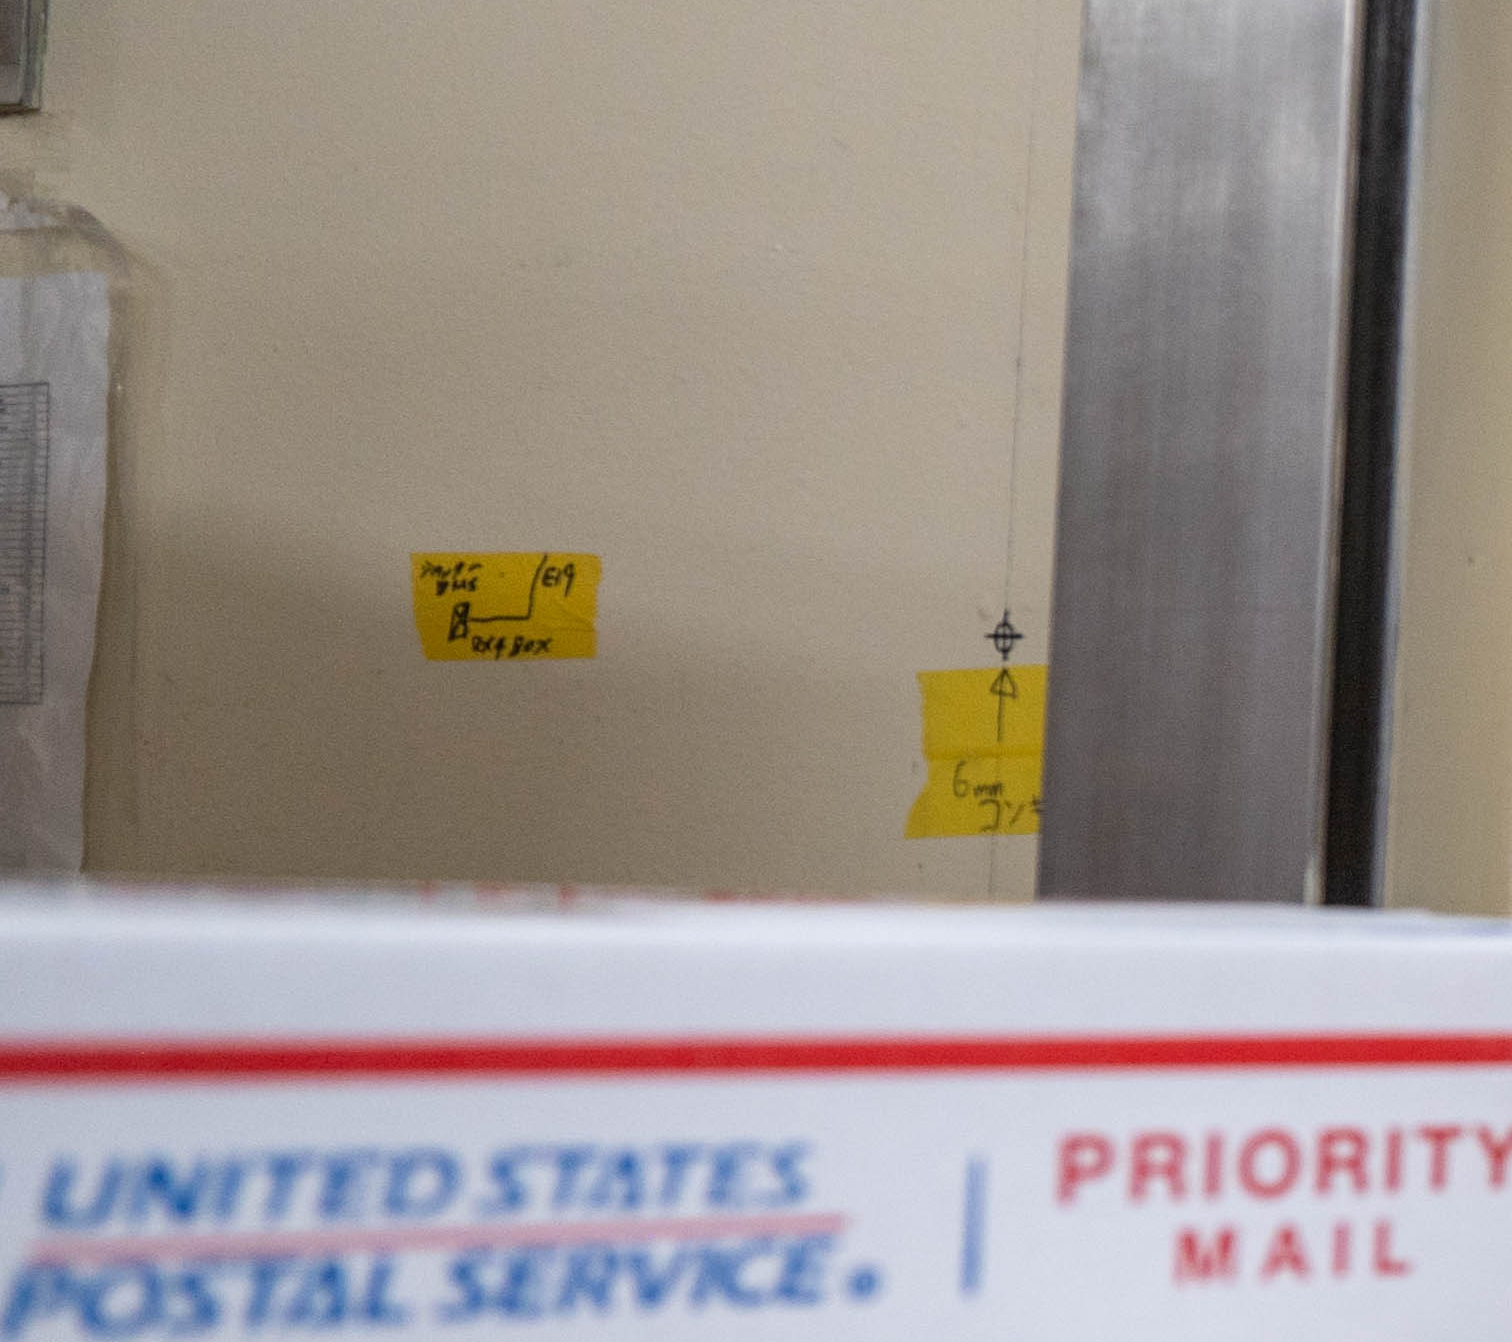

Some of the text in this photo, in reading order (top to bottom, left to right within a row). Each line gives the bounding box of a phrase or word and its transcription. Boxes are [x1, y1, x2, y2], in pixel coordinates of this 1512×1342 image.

[42, 1139, 812, 1230] UNITED STATES
[1174, 1217, 1415, 1289] MAIL
